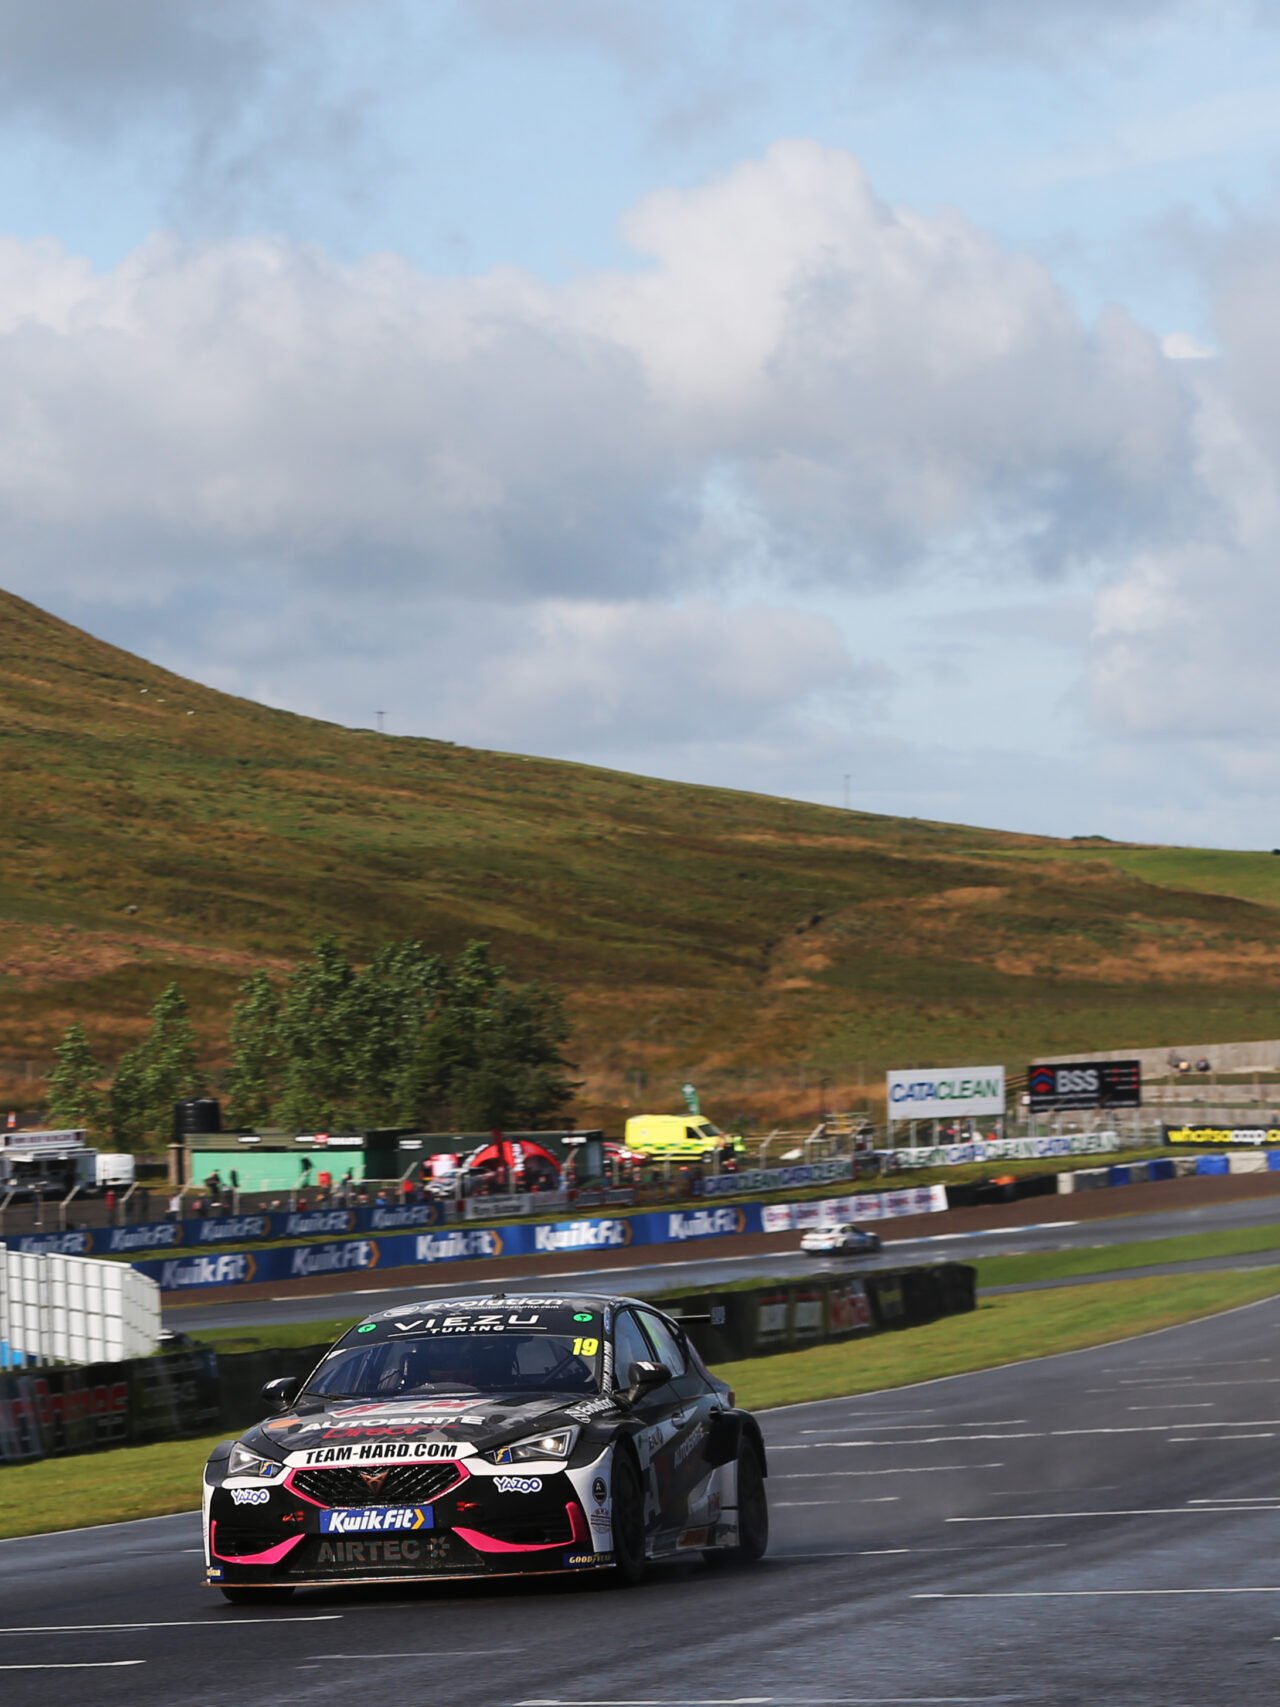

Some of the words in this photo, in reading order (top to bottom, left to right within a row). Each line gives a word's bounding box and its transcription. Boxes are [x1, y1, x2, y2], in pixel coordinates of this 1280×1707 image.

[1056, 1069, 1099, 1093] BSS
[890, 1079, 1000, 1103] CATACLEAN
[424, 1298, 563, 1311] Evolution
[394, 1315, 540, 1331] VIEZU
[430, 1325, 505, 1334] TUNING
[572, 1337, 599, 1356] 19
[298, 1415, 486, 1434] AUTOBRITE
[306, 1445, 458, 1465] TEAM-HARD.COM
[493, 1476, 543, 1494] YAZOO
[230, 1489, 271, 1506] YAZOO
[317, 1540, 421, 1563] AIRTEC
